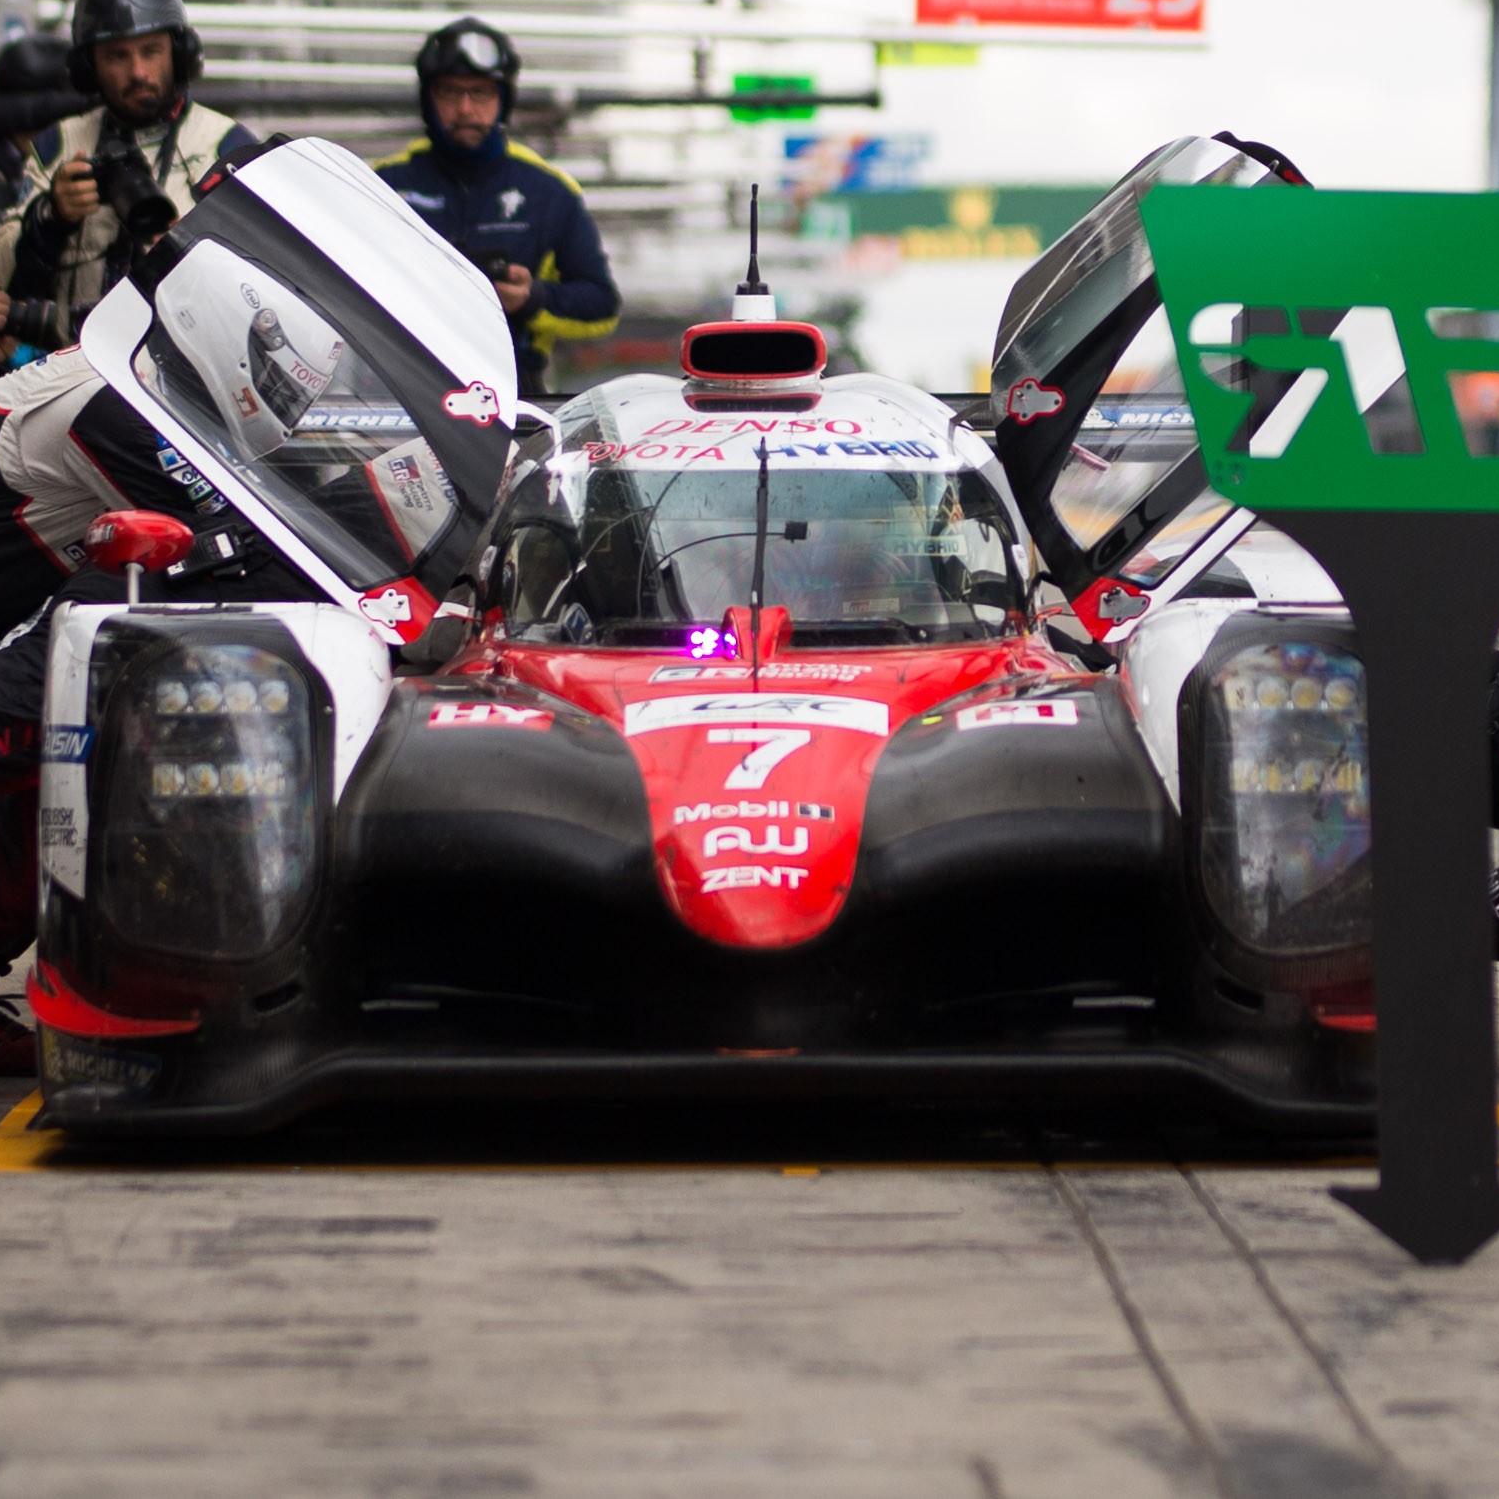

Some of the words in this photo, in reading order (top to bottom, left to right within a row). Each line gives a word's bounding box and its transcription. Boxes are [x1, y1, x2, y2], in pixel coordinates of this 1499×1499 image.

[642, 418, 863, 436] DENSO
[574, 442, 726, 462] TOYOTA
[752, 439, 940, 460] HYBRID
[436, 704, 545, 724] HY
[707, 729, 811, 790] 7
[674, 801, 790, 824] Mobil
[702, 865, 809, 893] ZENT
